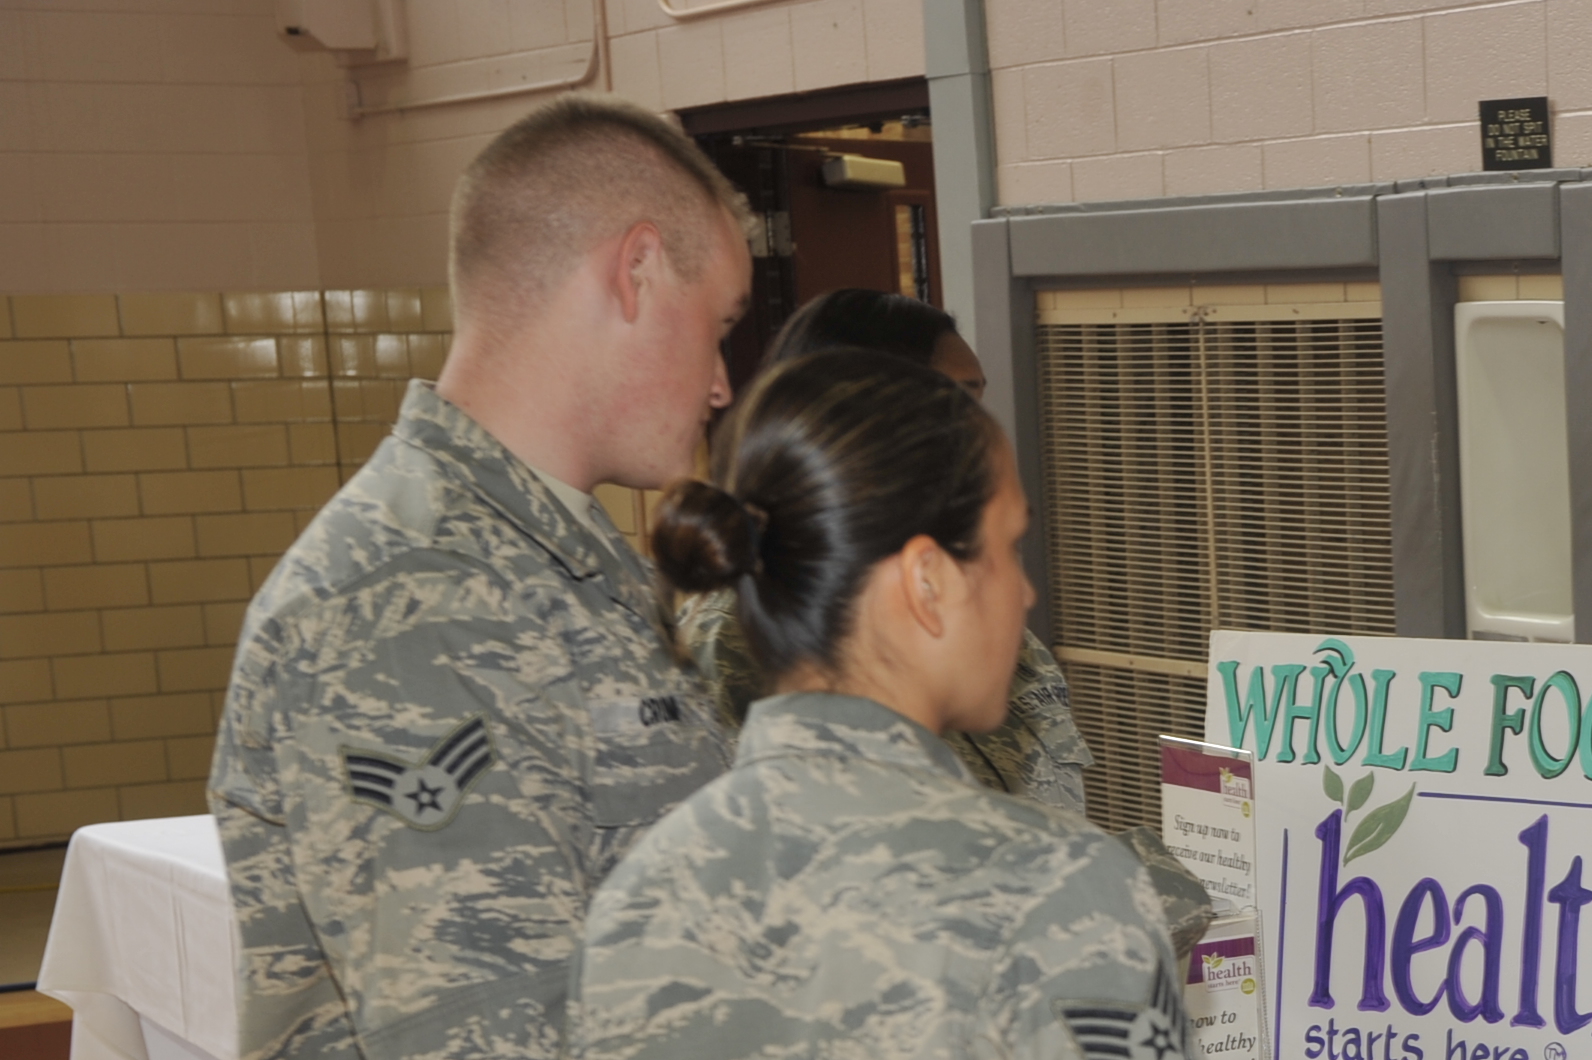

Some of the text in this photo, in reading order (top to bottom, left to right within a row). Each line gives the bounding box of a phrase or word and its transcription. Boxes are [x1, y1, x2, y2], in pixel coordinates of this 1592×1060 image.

[1498, 109, 1531, 122] PLEASE
[1487, 121, 1543, 136] DO NOT SPIT
[1485, 134, 1548, 148] IN THE WATER
[1495, 148, 1539, 161] FOUNTAIN
[1217, 638, 1464, 772] WHOLE
[1174, 814, 1240, 842] Sign up now to
[1199, 851, 1215, 863] our
[1218, 850, 1251, 876] healthy
[1207, 962, 1252, 981] health
[1220, 1011, 1237, 1025] to
